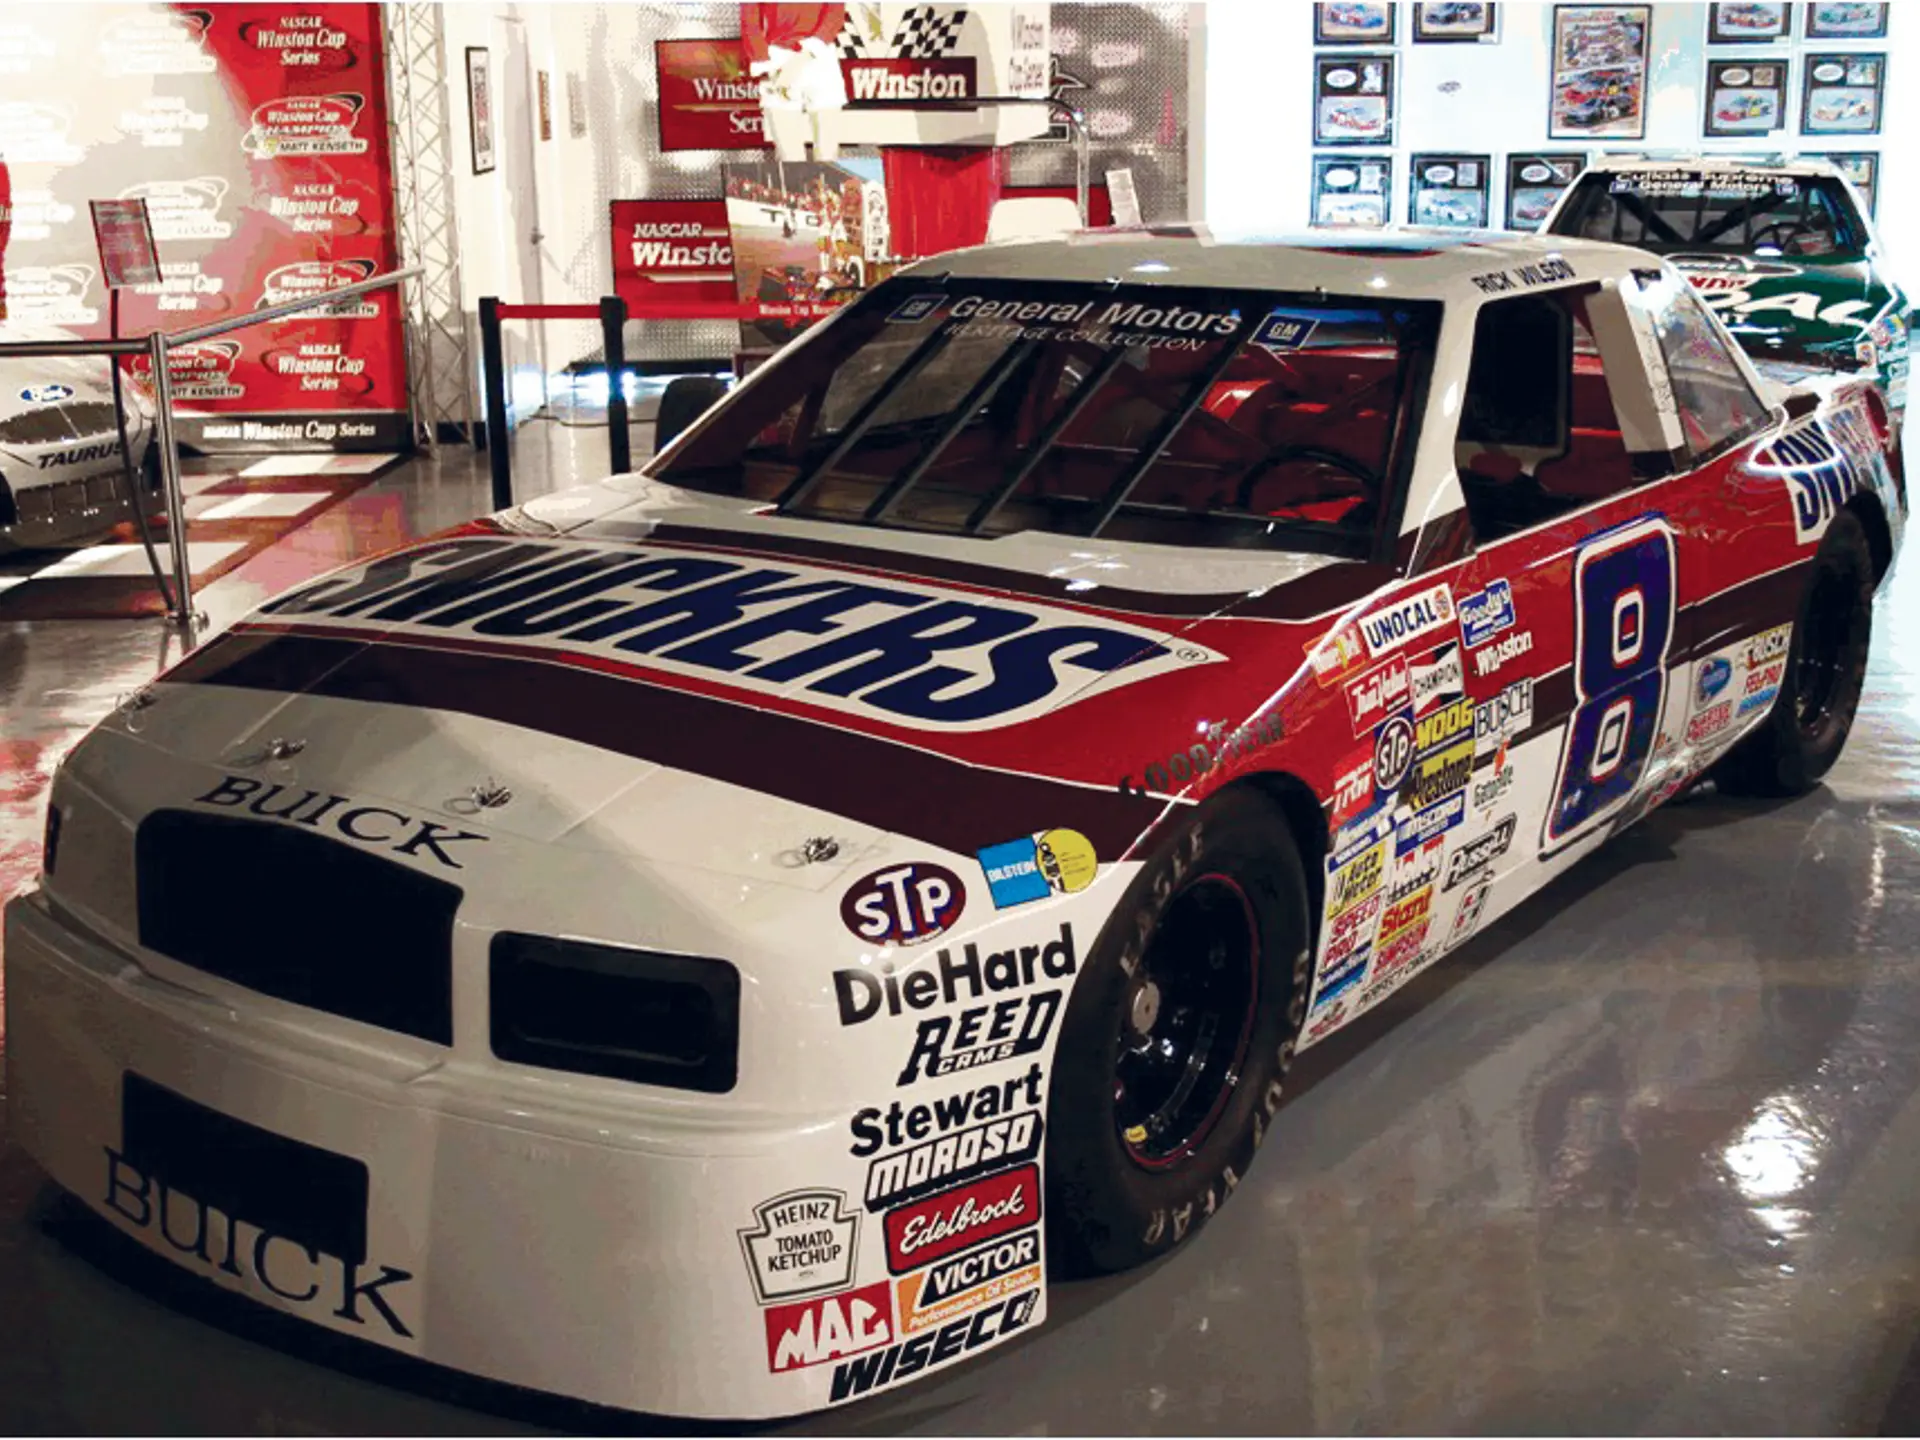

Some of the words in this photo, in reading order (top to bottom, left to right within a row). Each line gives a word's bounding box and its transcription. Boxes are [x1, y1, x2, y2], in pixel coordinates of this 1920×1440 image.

[257, 30, 315, 49] Winston
[316, 28, 347, 49] Cup
[280, 15, 323, 28] NASCAR
[281, 49, 320, 65] Series
[851, 66, 967, 99] Winston
[631, 240, 732, 266] Winsto
[633, 223, 702, 238] NASCAR
[1471, 272, 1517, 294] RICK
[1512, 258, 1576, 287] WILSON
[943, 324, 1051, 341] HERITAGE
[1054, 329, 1206, 352] COLLECTION
[950, 295, 1094, 322] General
[1097, 302, 1241, 334] Motors
[279, 357, 334, 374] Winston
[335, 356, 365, 375] Cup
[300, 376, 339, 390] Series
[243, 421, 302, 440] Winston
[306, 420, 336, 439] Cup
[340, 423, 376, 437] Series
[257, 539, 1172, 722] SNICKERS
[1366, 598, 1438, 649] UNOCAL
[1476, 682, 1532, 736] BUSCH
[1541, 519, 1678, 855] 8
[1415, 698, 1475, 750] MOOG
[1379, 726, 1409, 779] STP
[193, 776, 490, 869] BUICK
[855, 866, 951, 937] STP
[833, 921, 1077, 1027] DieHard
[896, 989, 1063, 1087] REED
[937, 1042, 1016, 1074] CAMS
[850, 1063, 1043, 1158] Stewart
[867, 1113, 1037, 1201] MOROSO
[774, 1202, 829, 1228] HEINZ
[776, 1229, 833, 1252] TOMATO
[900, 1184, 1025, 1255] Edelbrock
[103, 1146, 414, 1340] BUICK
[768, 1244, 841, 1272] KETCHUP
[933, 1237, 1035, 1295] VICTOR
[773, 1298, 890, 1370] MAC
[829, 1289, 1036, 1403] WISECO
